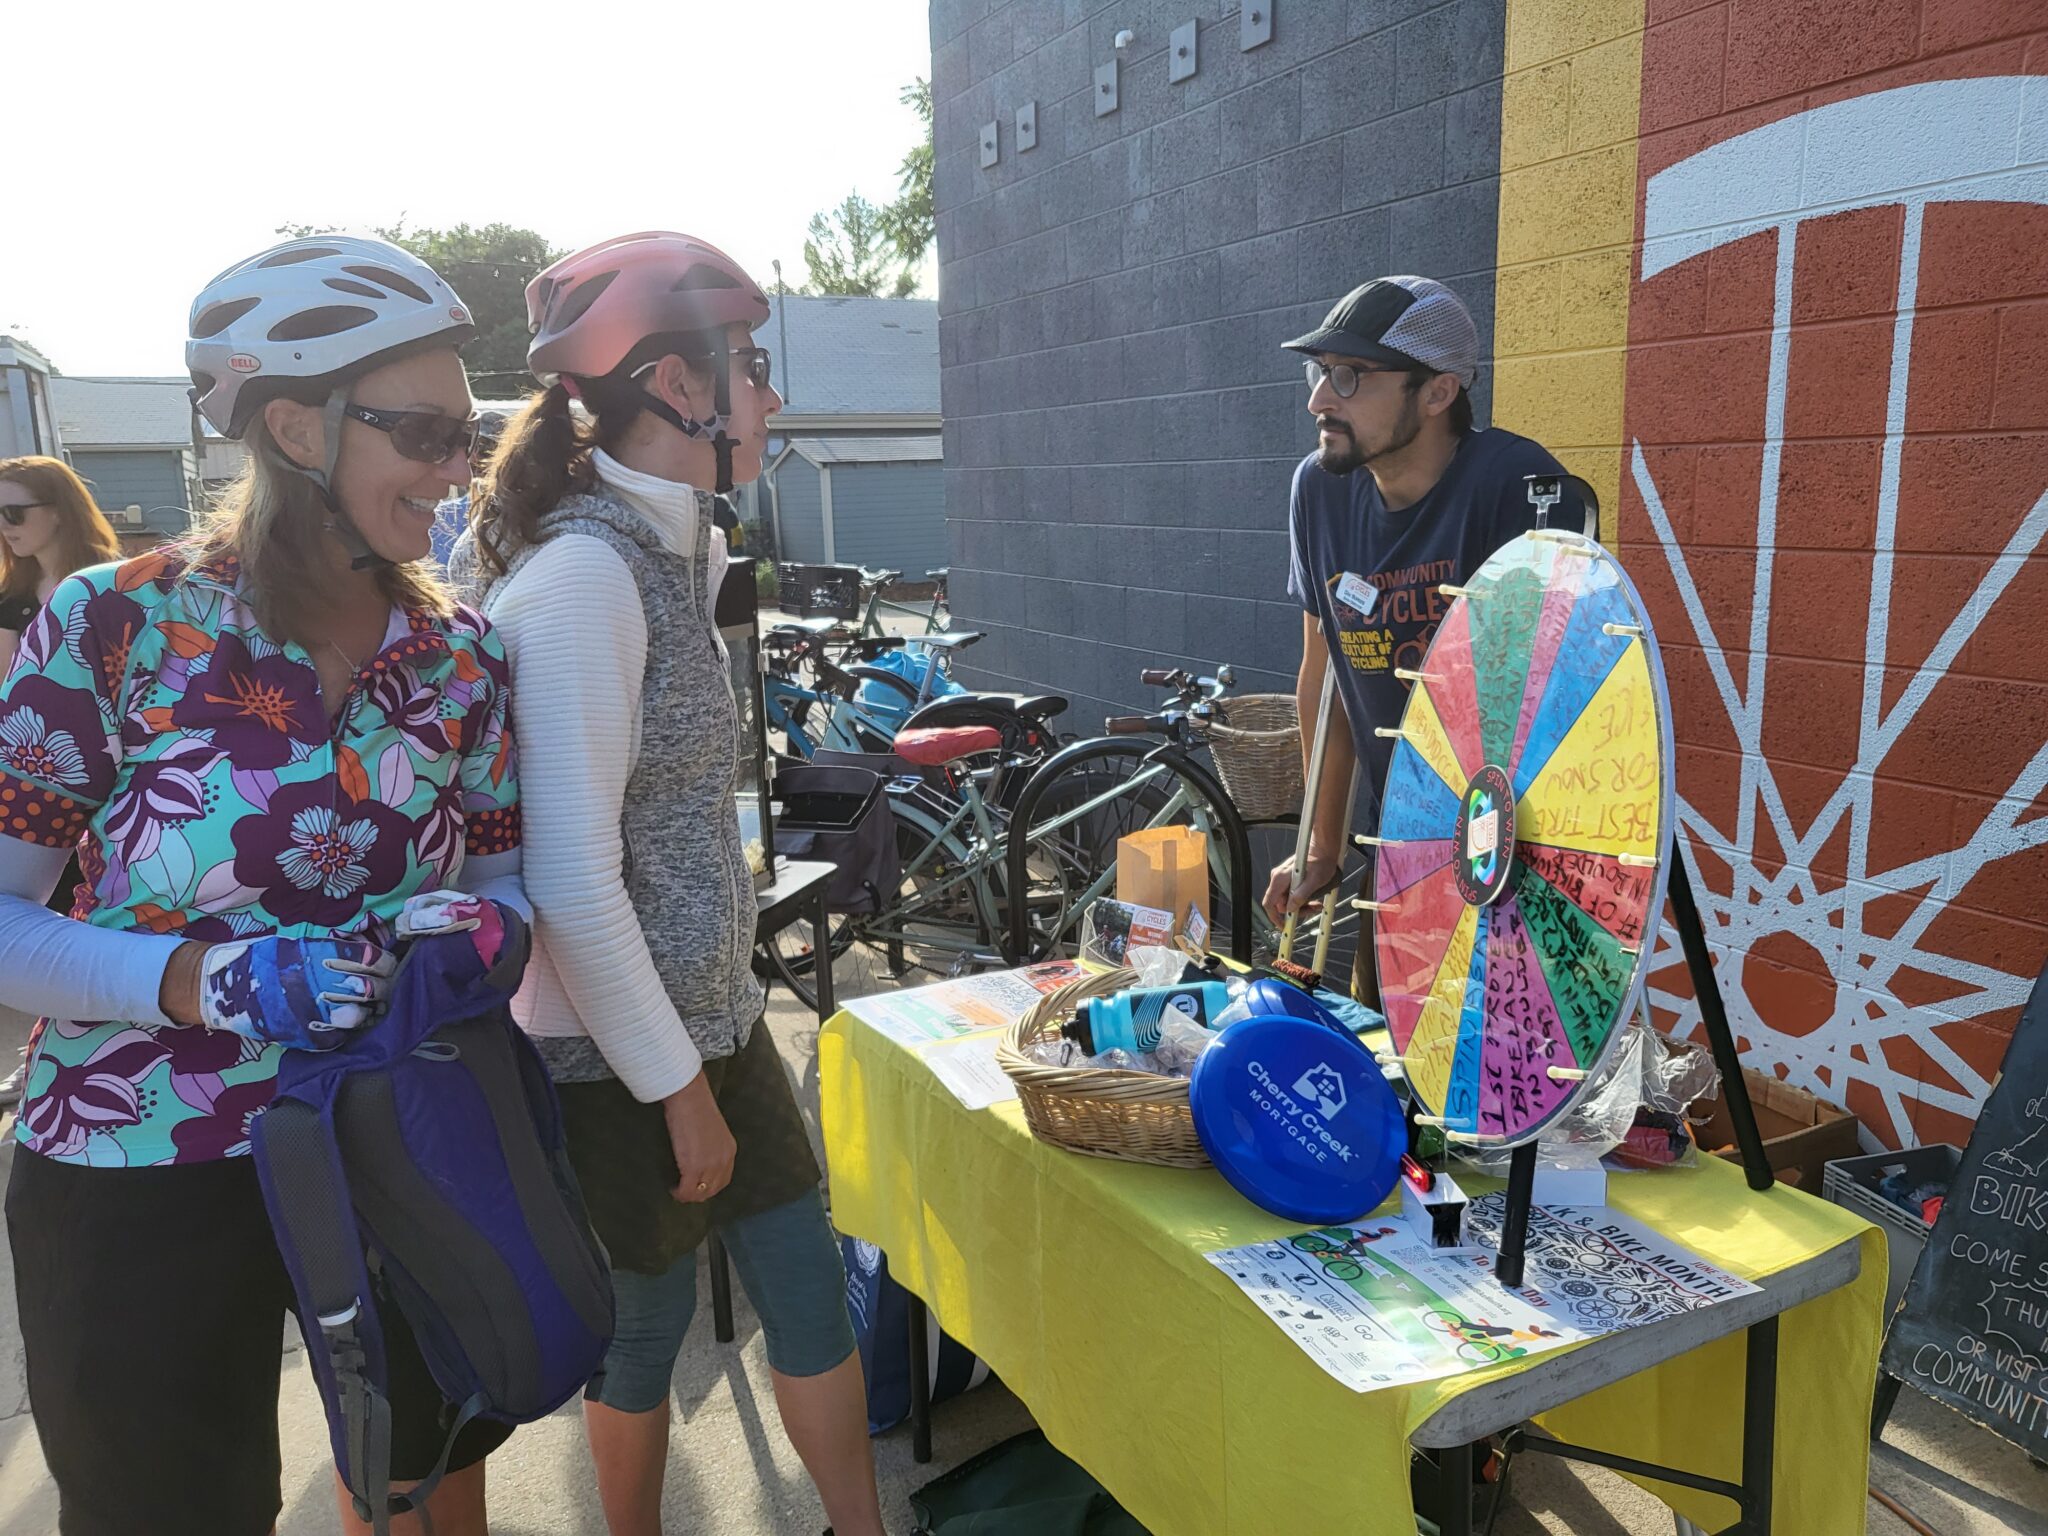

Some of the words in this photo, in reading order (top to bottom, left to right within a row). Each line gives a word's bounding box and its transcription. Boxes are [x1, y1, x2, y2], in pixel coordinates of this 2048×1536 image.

[1340, 631, 1380, 644] CREATING
[1384, 628, 1394, 641] A
[1341, 643, 1376, 656] CULTURE
[1378, 642, 1392, 655] OF
[1350, 656, 1389, 669] CYCLING
[1453, 816, 1464, 855] WIN
[1486, 770, 1506, 794] SPIN
[1501, 818, 1513, 859] WIN
[1460, 879, 1478, 902] SPIN
[1452, 1018, 1478, 1117] SPIN
[1247, 1061, 1303, 1116] Cherry
[1301, 1112, 1353, 1164] Creek
[1249, 1089, 1328, 1163] MORTGAGE
[1970, 1175, 2048, 1231] BIK
[1596, 1225, 1650, 1256] BIKE
[1646, 1254, 1733, 1298] MONTH
[1690, 1261, 1719, 1276] JUNE
[1716, 1274, 1749, 1290] 2022
[1950, 1234, 2028, 1277] COME
[1471, 1255, 1490, 1267] To
[1520, 1289, 1552, 1307] Day
[2003, 1296, 2048, 1329] THU
[1956, 1335, 1987, 1362] OR
[1995, 1349, 2038, 1384] VISIT
